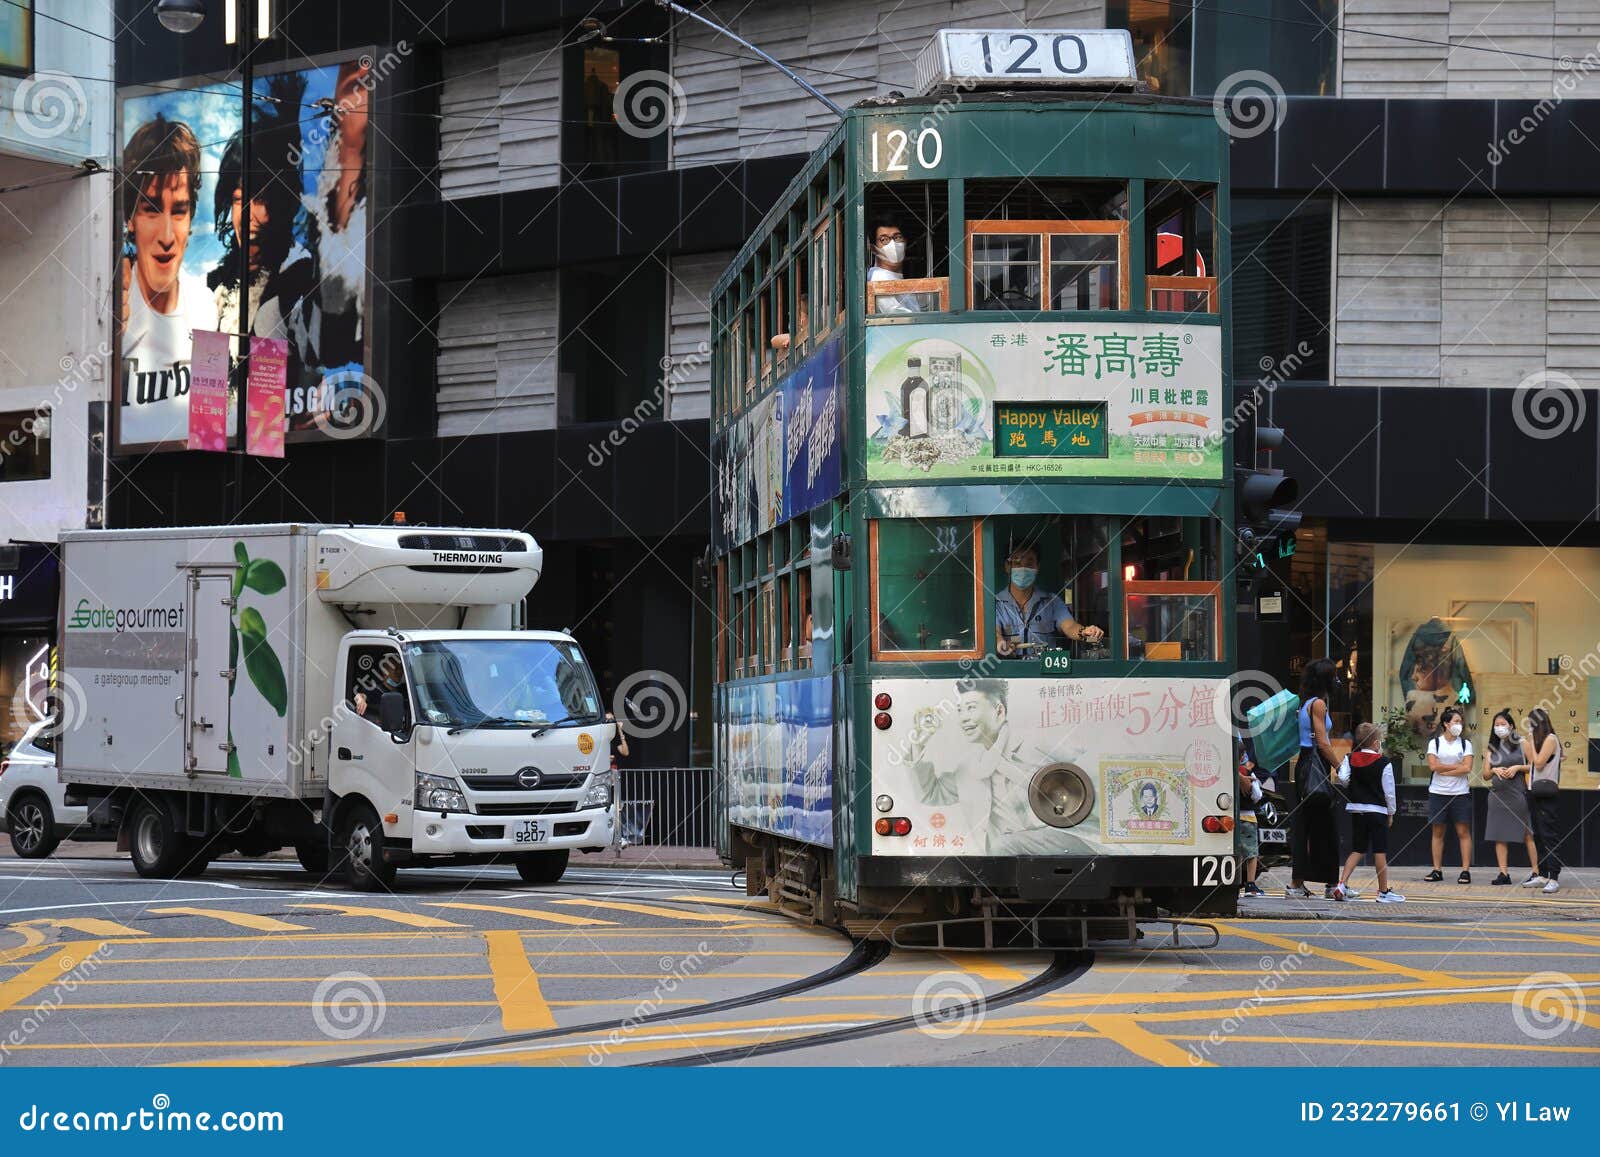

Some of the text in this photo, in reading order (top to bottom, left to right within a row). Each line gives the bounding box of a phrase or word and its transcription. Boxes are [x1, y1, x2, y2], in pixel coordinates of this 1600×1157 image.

[982, 34, 1088, 74] 120
[871, 128, 943, 172] 120
[990, 332, 1029, 347] 香港
[1131, 388, 1208, 406] 川貝枇杷露
[999, 408, 1099, 428] Happy Valley
[1009, 431, 1091, 448] 跑馬地
[432, 552, 502, 564] THERMO KING
[1044, 656, 1068, 668] 049
[101, 674, 138, 687] gategroup
[140, 673, 172, 685] member
[523, 821, 538, 832] TS
[516, 830, 546, 842] 9207
[1193, 855, 1236, 887] 120
